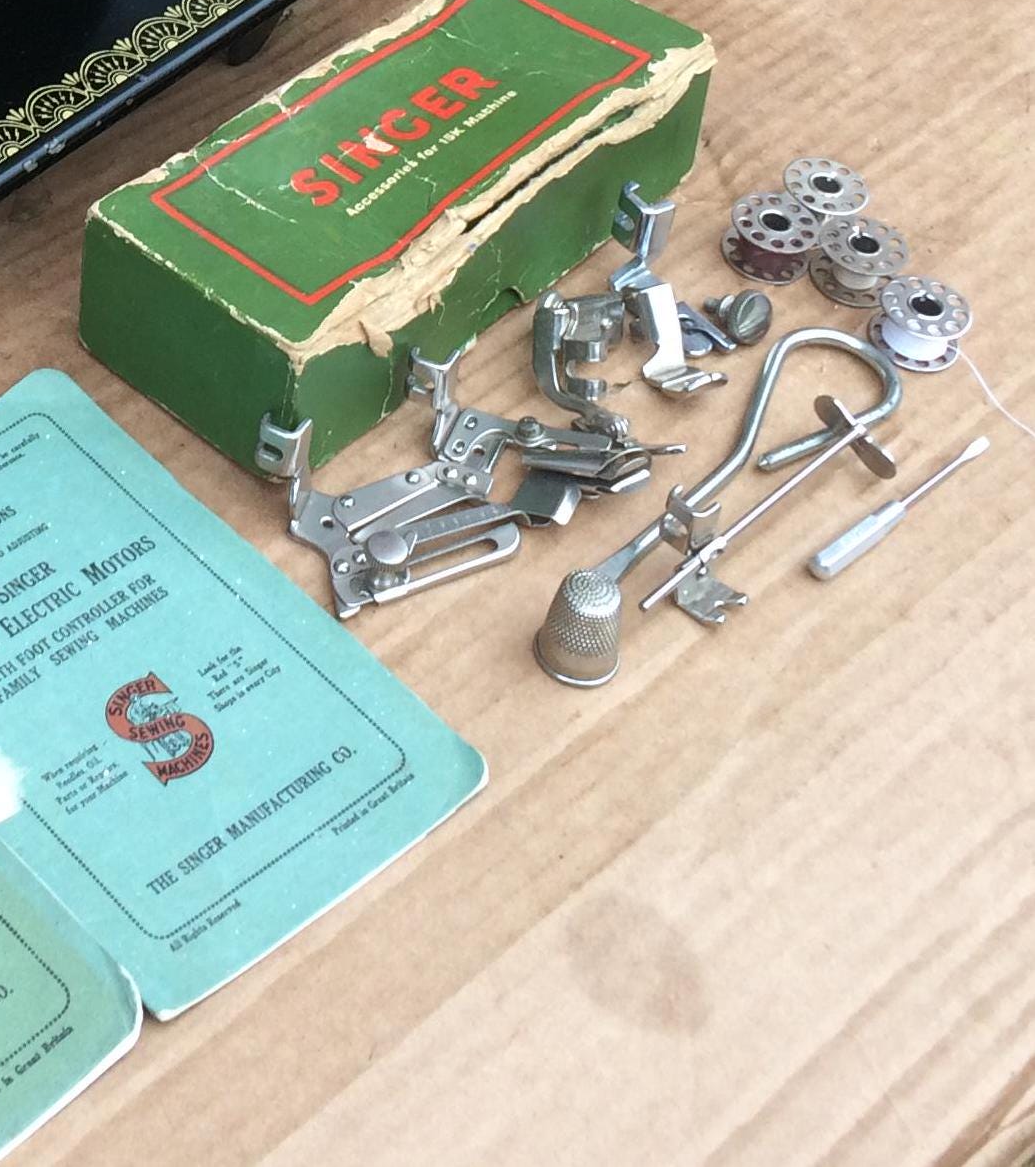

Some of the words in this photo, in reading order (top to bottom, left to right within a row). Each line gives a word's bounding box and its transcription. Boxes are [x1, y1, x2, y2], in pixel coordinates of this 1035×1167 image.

[289, 65, 501, 207] SINGER
[346, 158, 419, 217] Accessories
[417, 144, 439, 160] for
[438, 126, 466, 145] 15K
[463, 89, 518, 128] Machine
[5, 522, 50, 553] ADJUSTING
[81, 534, 157, 586] MOTORS
[16, 637, 52, 668] FOOT
[51, 588, 131, 644] CONTROLLER
[128, 573, 157, 596] FOR
[49, 630, 101, 667] SEWING
[104, 585, 169, 631] MACHINES
[197, 663, 218, 678] Look
[218, 654, 230, 667] for
[229, 645, 244, 659] the
[207, 684, 232, 701] There
[247, 657, 269, 676] Singer
[108, 678, 157, 717] SINGER
[214, 696, 238, 713] Shops
[237, 689, 246, 699] in
[264, 664, 282, 680] City
[128, 714, 186, 741] SEWING
[156, 731, 210, 778] MACHINES
[55, 788, 79, 807] Parts
[65, 800, 80, 816] for
[78, 790, 98, 810] your
[96, 769, 129, 794] Machine
[331, 813, 362, 837] Printed
[360, 807, 370, 817] in
[367, 791, 390, 810] Great
[388, 772, 416, 796] Britain
[146, 868, 180, 897] THE
[177, 835, 228, 877] SINGER
[225, 760, 333, 842] MANUFACTURING
[332, 745, 357, 765] CO.
[169, 940, 184, 953] All
[183, 921, 208, 943] Rights
[206, 899, 242, 927] Reserved
[3, 1074, 15, 1087] in
[15, 1051, 42, 1076] Great
[41, 1024, 74, 1054] Britain
